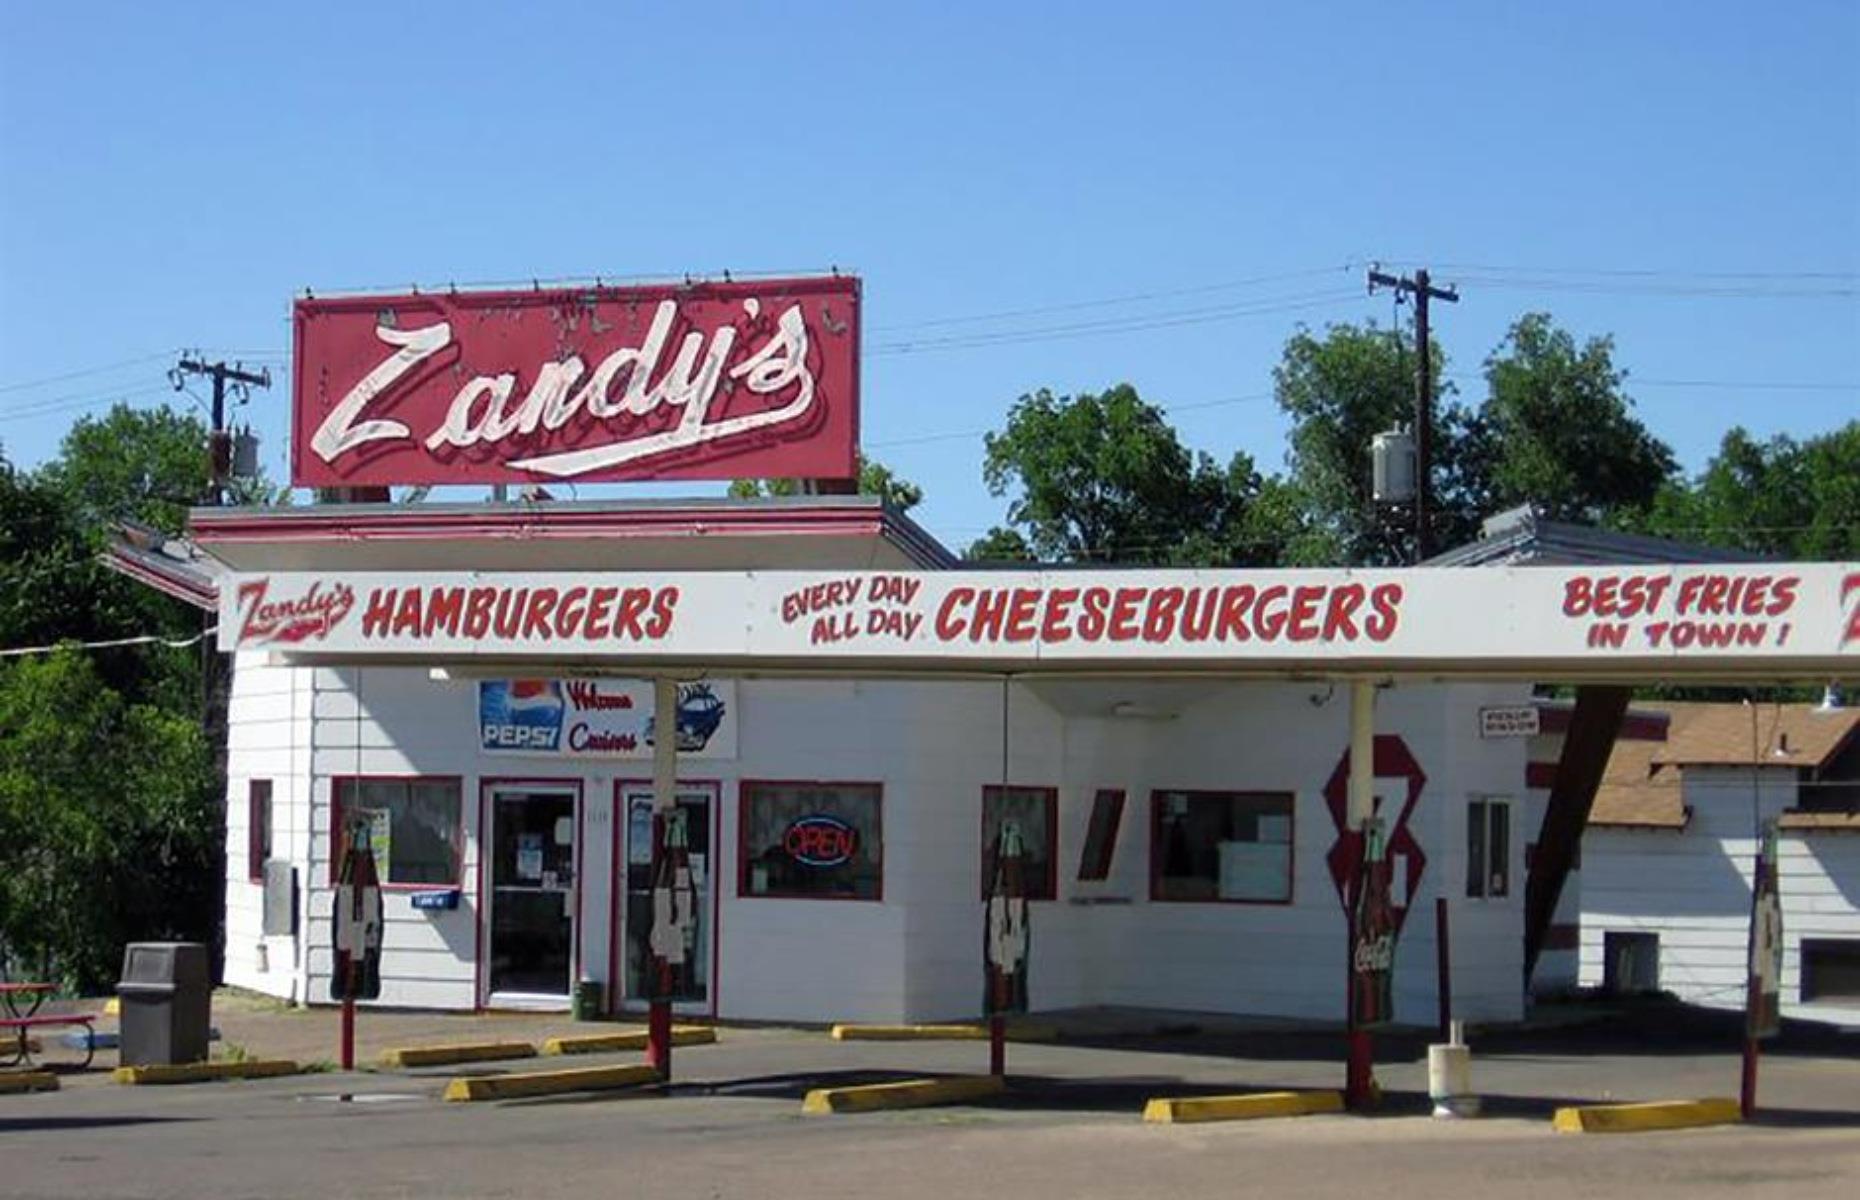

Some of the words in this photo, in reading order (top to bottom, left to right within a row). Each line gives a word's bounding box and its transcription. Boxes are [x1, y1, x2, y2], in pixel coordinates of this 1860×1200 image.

[308, 299, 811, 475] Zandy's
[236, 577, 355, 646] Zandy's
[362, 586, 680, 641] HAMBURGERS
[782, 577, 862, 623] EVERY
[868, 575, 920, 605] DAY
[934, 584, 1403, 643] CHEESEBURGERS
[1562, 574, 1671, 618] BEST
[1675, 575, 1800, 616] FRIES
[811, 611, 859, 645] ALL
[867, 608, 922, 641] DAY
[1587, 623, 1629, 648] IN
[484, 723, 558, 746] PEPSI
[784, 826, 856, 857] OPEN
